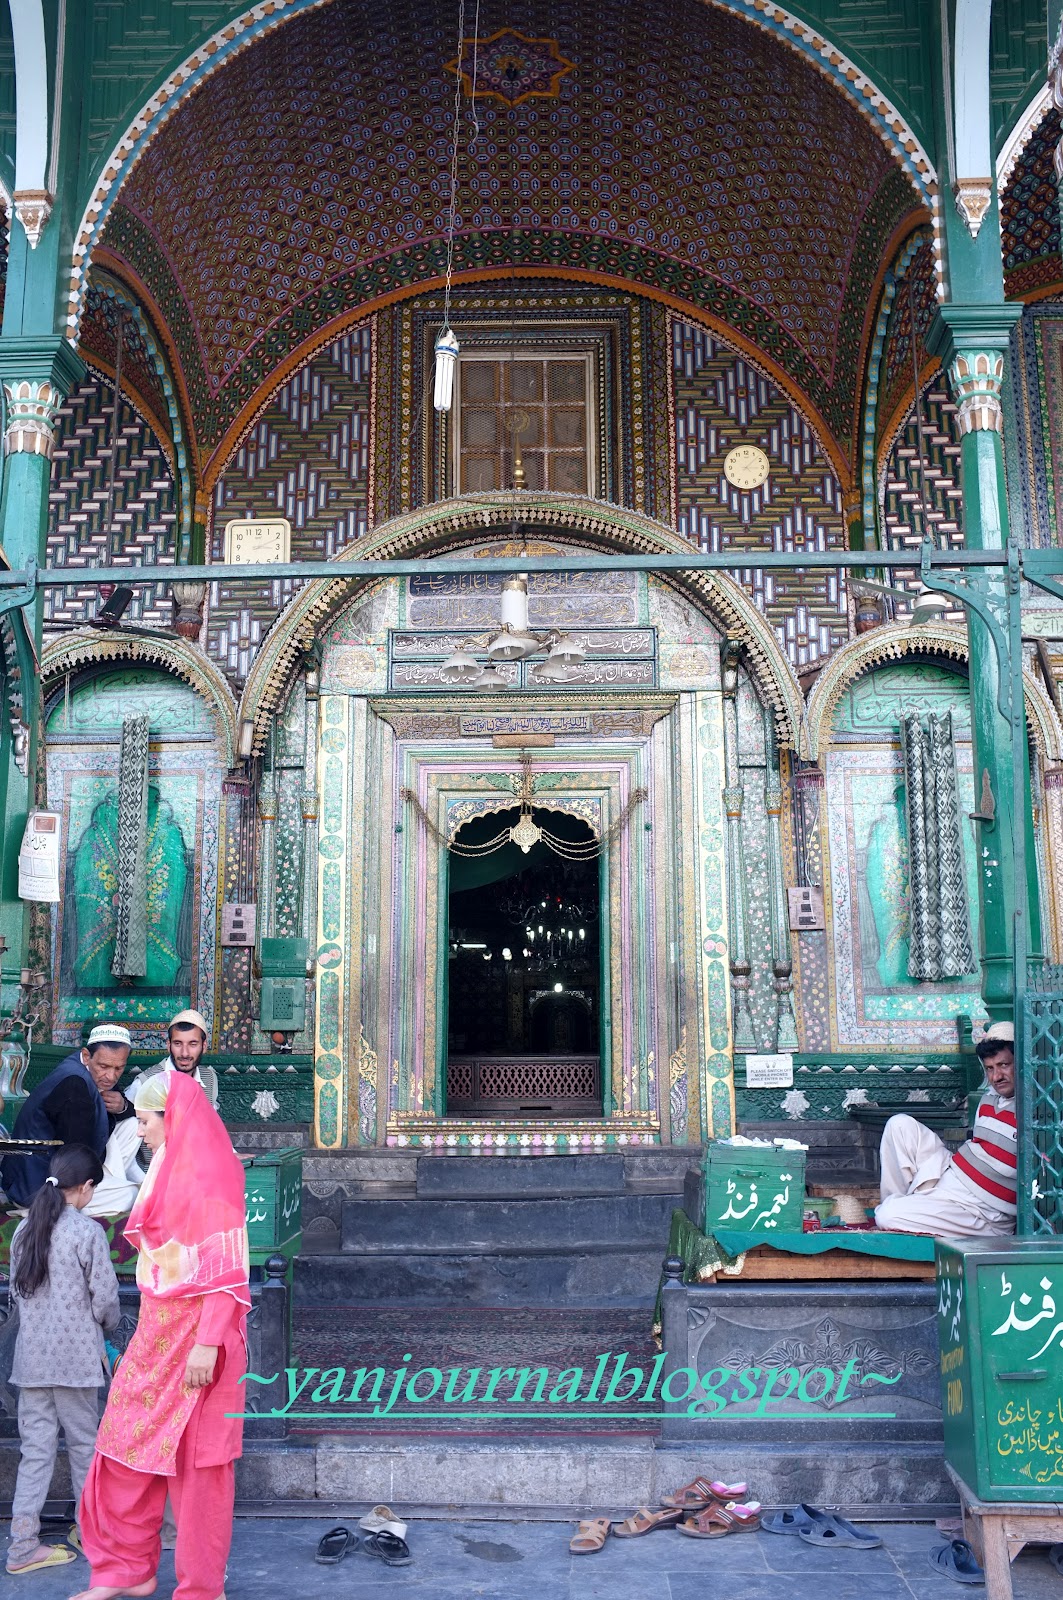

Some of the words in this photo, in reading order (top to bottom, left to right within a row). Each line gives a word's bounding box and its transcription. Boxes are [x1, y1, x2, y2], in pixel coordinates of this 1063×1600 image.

[255, 528, 262, 536] 12
[718, 1178, 759, 1220] فنڈ
[749, 1173, 793, 1231] تعمیر
[991, 1271, 1056, 1336] فنڈ
[947, 1379, 963, 1416] FUND
[997, 1398, 1042, 1430] چاندی
[1035, 1456, 1063, 1482] کریہ
